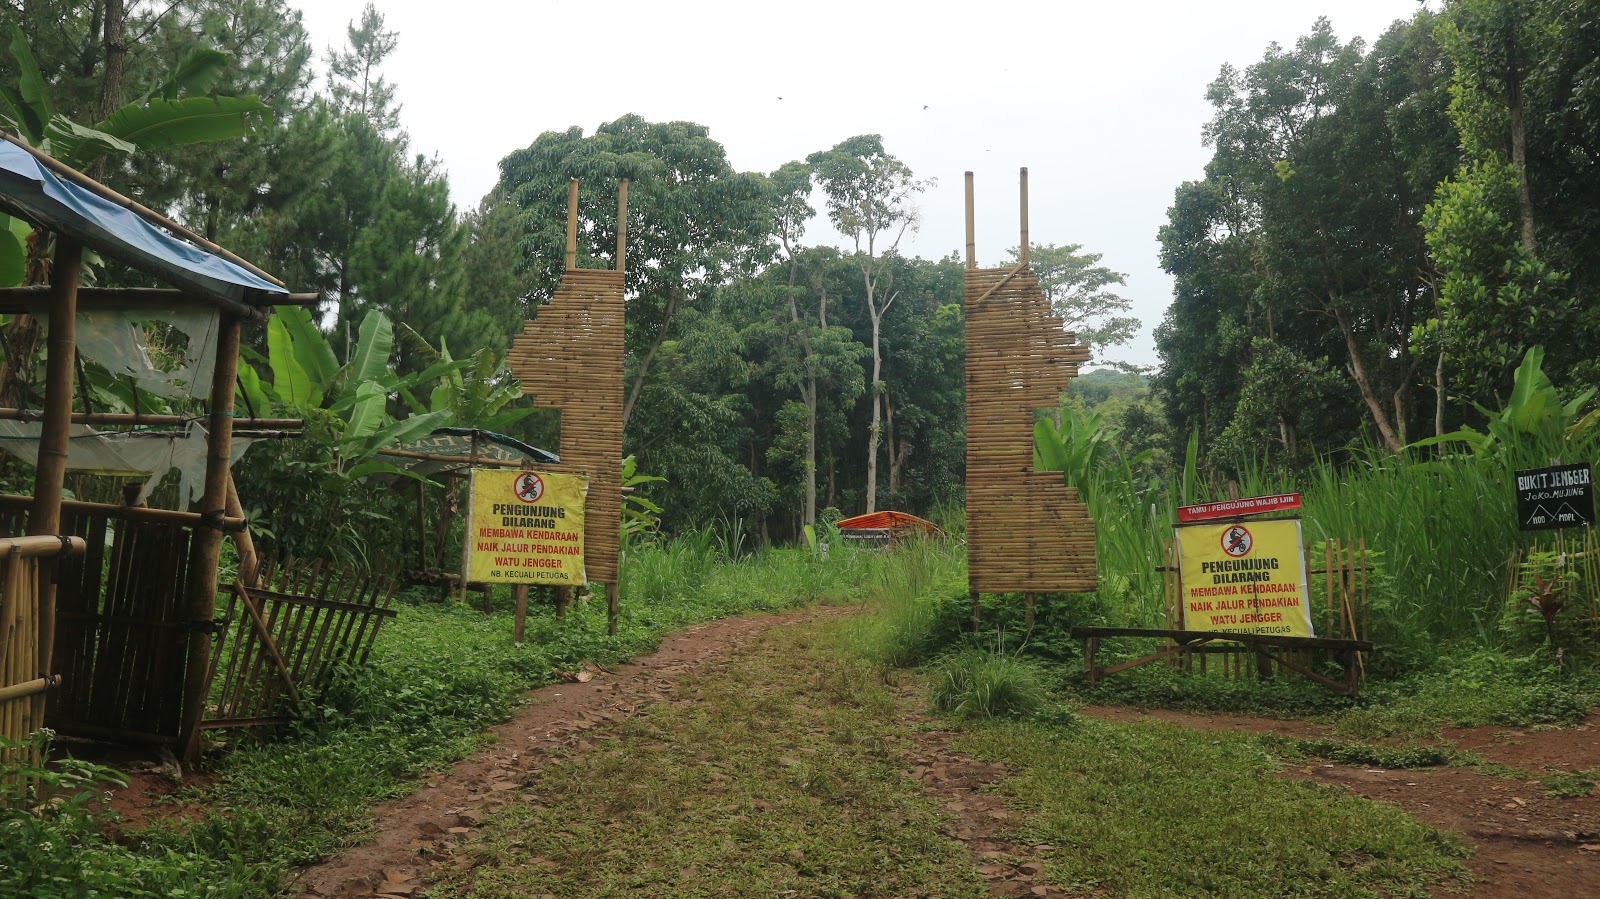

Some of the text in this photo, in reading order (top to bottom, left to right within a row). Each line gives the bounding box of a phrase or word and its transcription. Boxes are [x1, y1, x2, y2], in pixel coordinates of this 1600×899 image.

[1518, 468, 1590, 491] BUKIT JENGGER
[492, 503, 566, 519] PENGUNJUNG
[1187, 506, 1207, 514] TAMU
[1212, 500, 1255, 512] PENGUJUNG
[1256, 497, 1278, 506] WAJIB
[1280, 496, 1294, 504] IJIN
[502, 516, 556, 529] DILARANG
[479, 527, 579, 542] MEMBAWA KENDARAAN
[477, 542, 580, 555] NAIK JALUR PENDAKIAN
[494, 556, 563, 569] WATU JENGGER
[1201, 557, 1279, 574] PENGUNJUNG
[490, 570, 569, 580] NB. KECUALI PETUGAS
[1213, 571, 1270, 585] DILARANG
[1190, 583, 1296, 598] MEMBAWA KENDARAAN
[1190, 597, 1299, 612] NAIK JALUR PENDAKIAN
[1210, 612, 1283, 625] WATU JENGGER
[1256, 625, 1291, 634] PETUGAS
